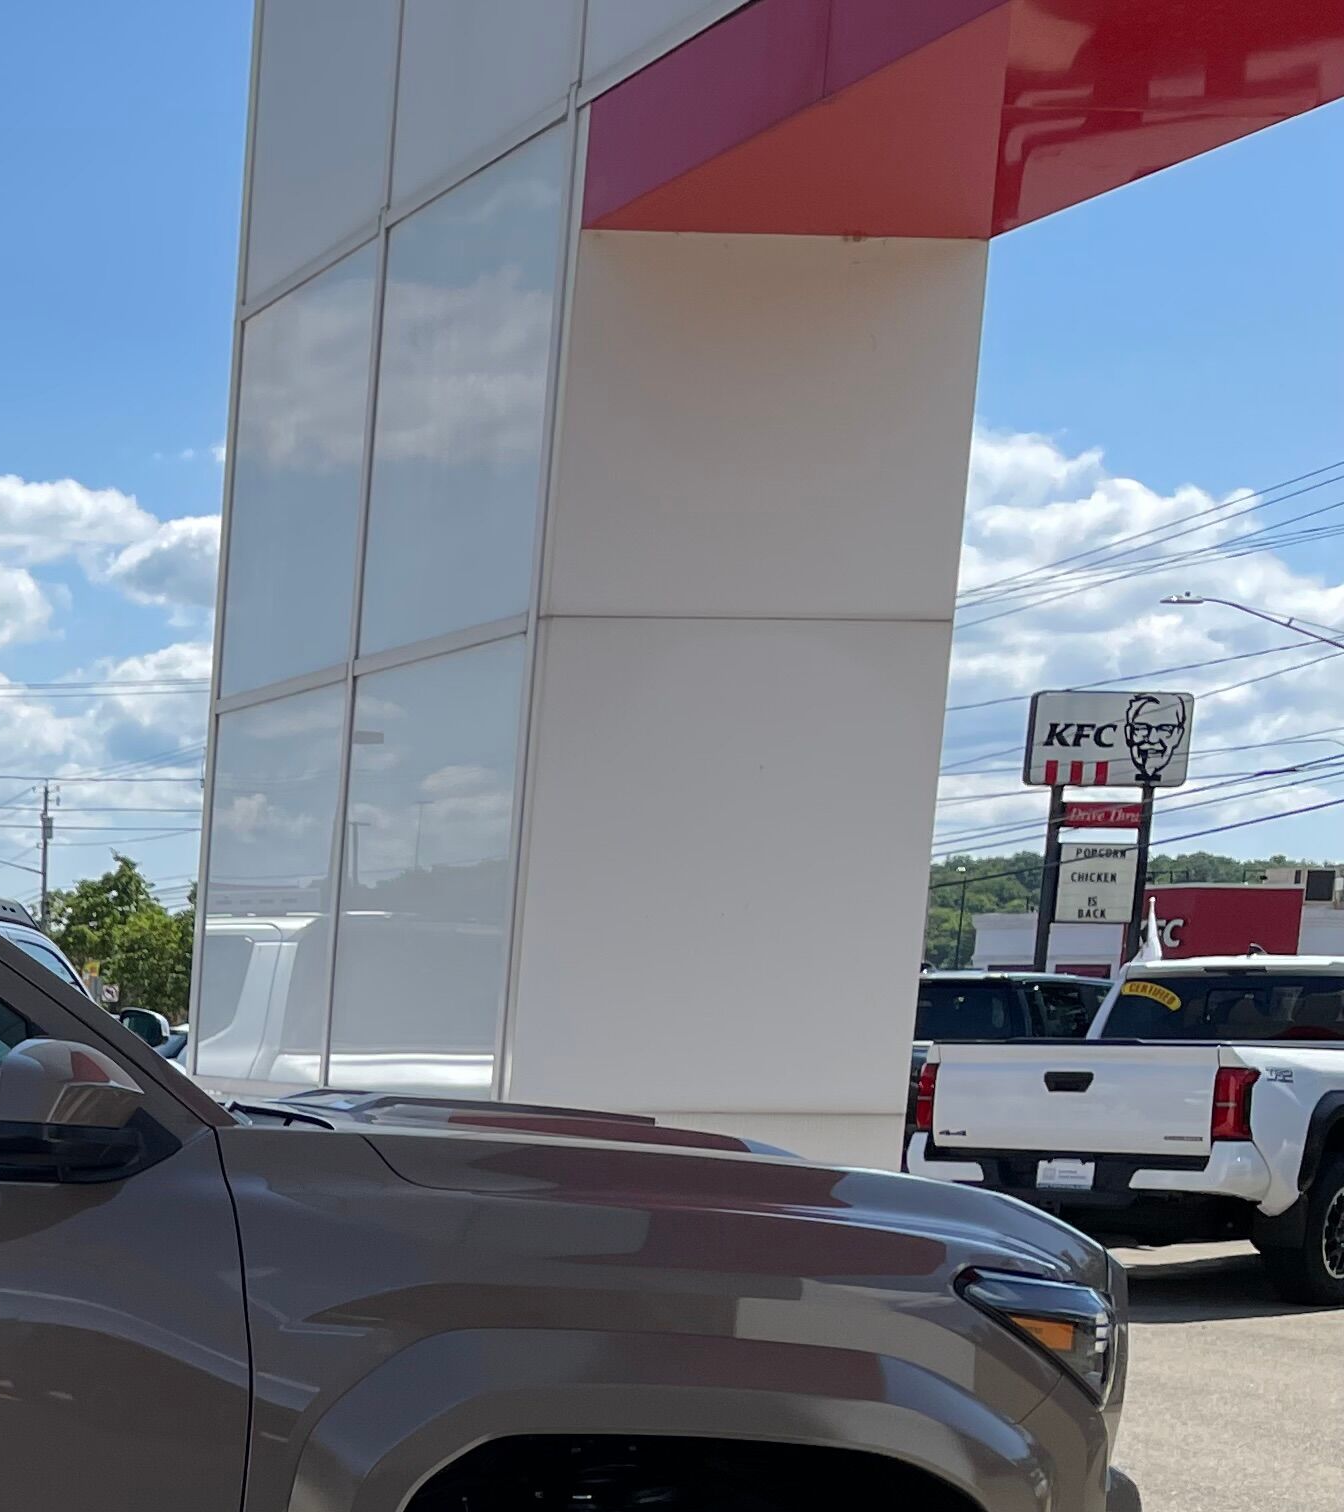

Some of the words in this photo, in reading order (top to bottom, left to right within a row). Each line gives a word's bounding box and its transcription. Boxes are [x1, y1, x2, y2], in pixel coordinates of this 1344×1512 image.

[1043, 722, 1117, 748] KFC
[1068, 808, 1105, 823] Drive
[1111, 808, 1141, 823] Thru
[1076, 847, 1126, 858] POPCORN
[1071, 871, 1117, 883] CHICKEN
[1088, 896, 1097, 906] IS
[1077, 908, 1106, 919] BACK
[1128, 983, 1176, 1006] CERTIFIED
